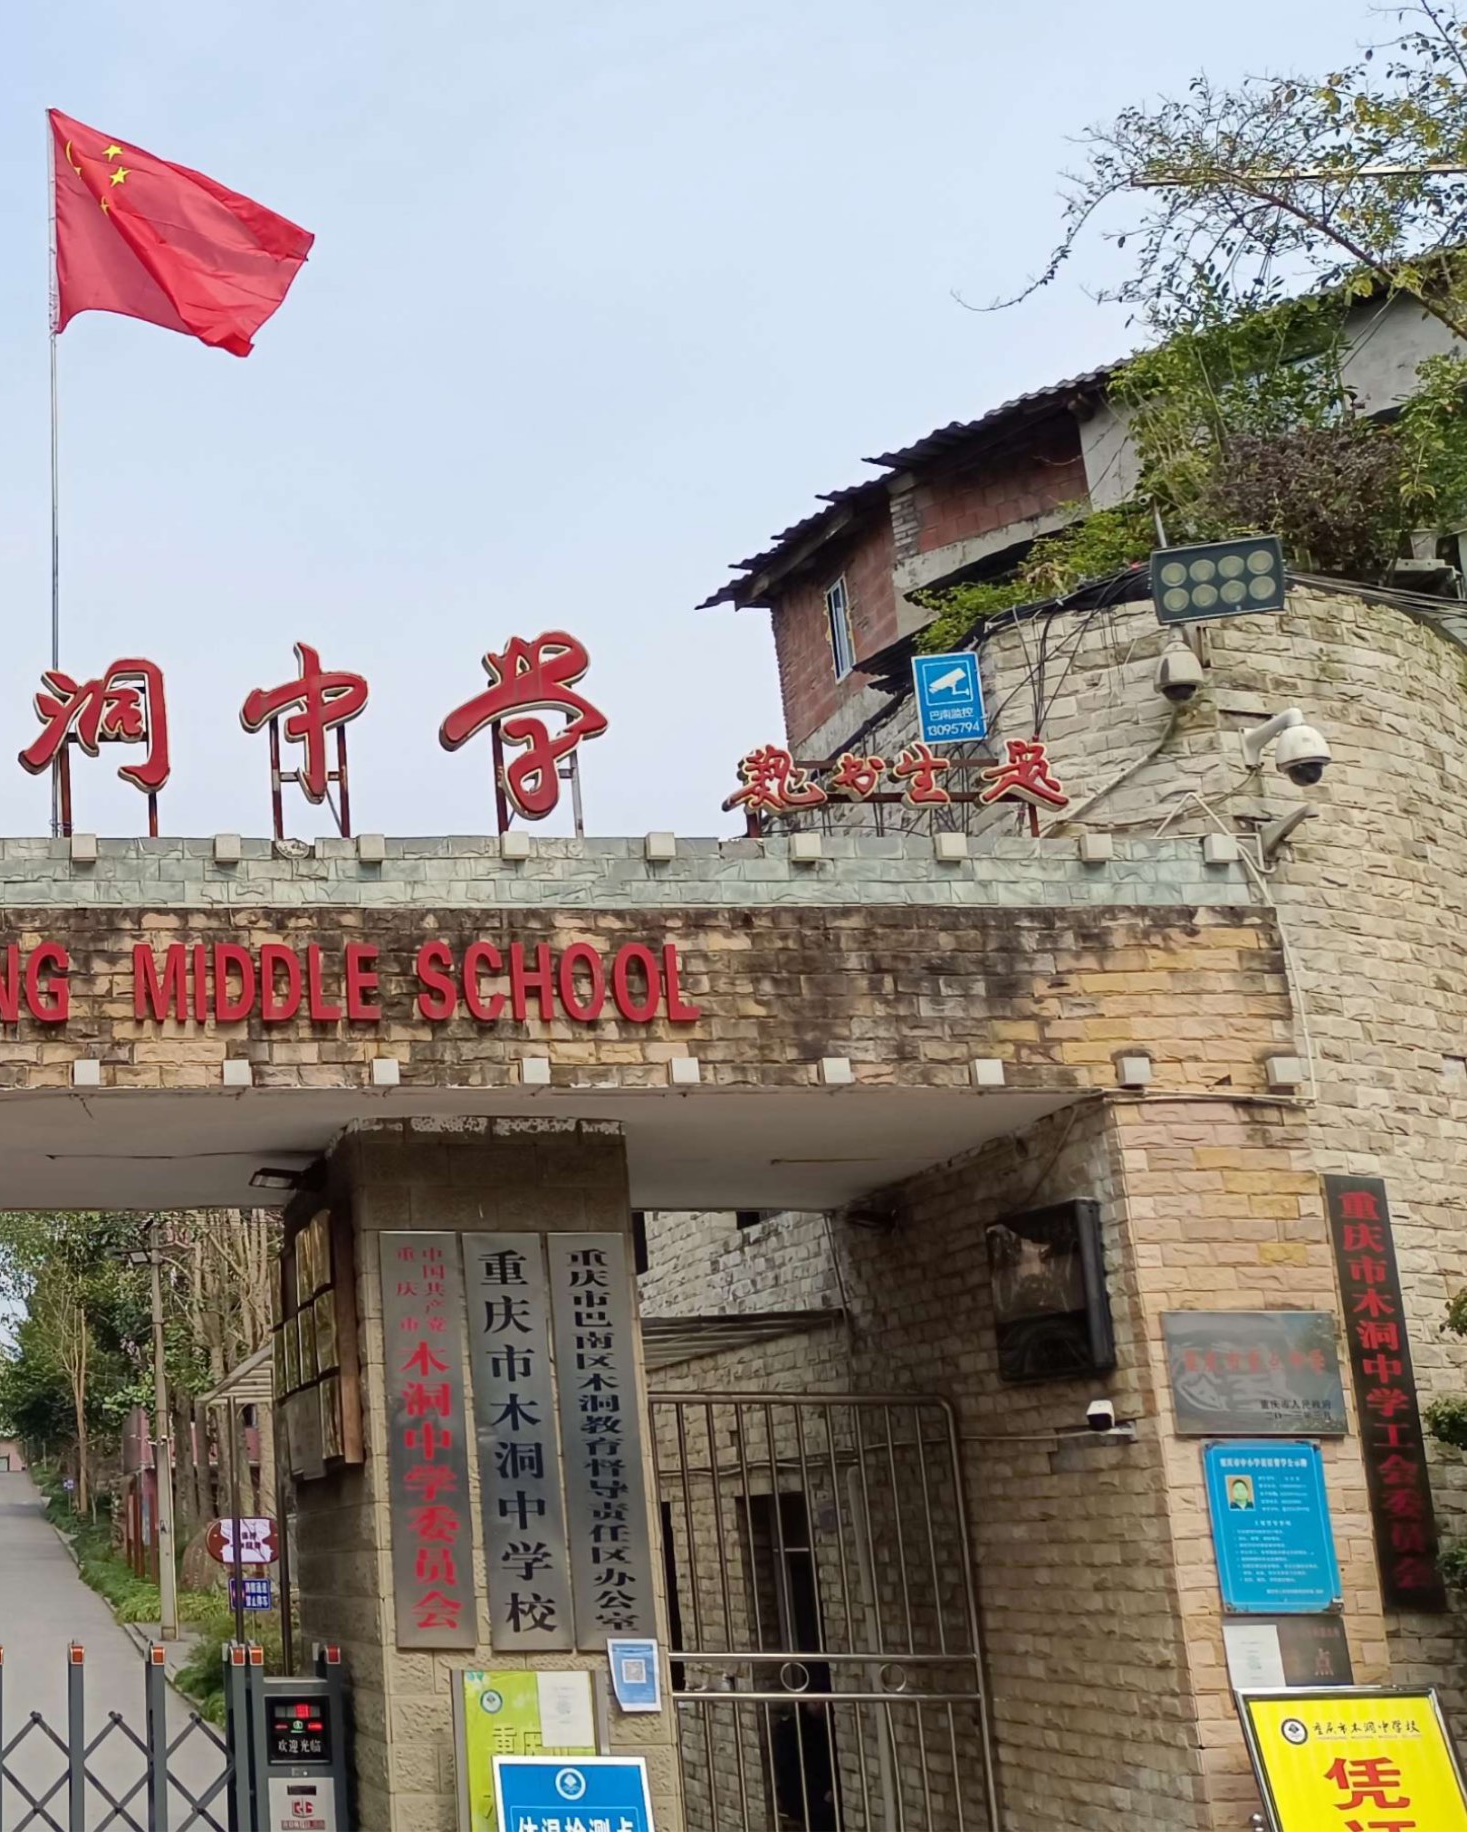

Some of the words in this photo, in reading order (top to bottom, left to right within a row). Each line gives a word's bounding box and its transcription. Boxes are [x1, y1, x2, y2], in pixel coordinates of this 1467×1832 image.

[132, 942, 382, 1024] MIDDLE
[417, 941, 702, 1024] SCHOOL
[396, 1246, 420, 1333] 重庆市
[421, 1246, 448, 1335] 中国共产党
[478, 1248, 559, 1633] 重庆市木洞中学校
[564, 1248, 645, 1632] 重庆市巴南区木洞教育督导责任区办公室
[1337, 1190, 1433, 1590] 重庆市木洞中学工会委员会
[399, 1340, 464, 1631] 木洞中学委员会
[277, 1739, 322, 1754] 欢迎光临
